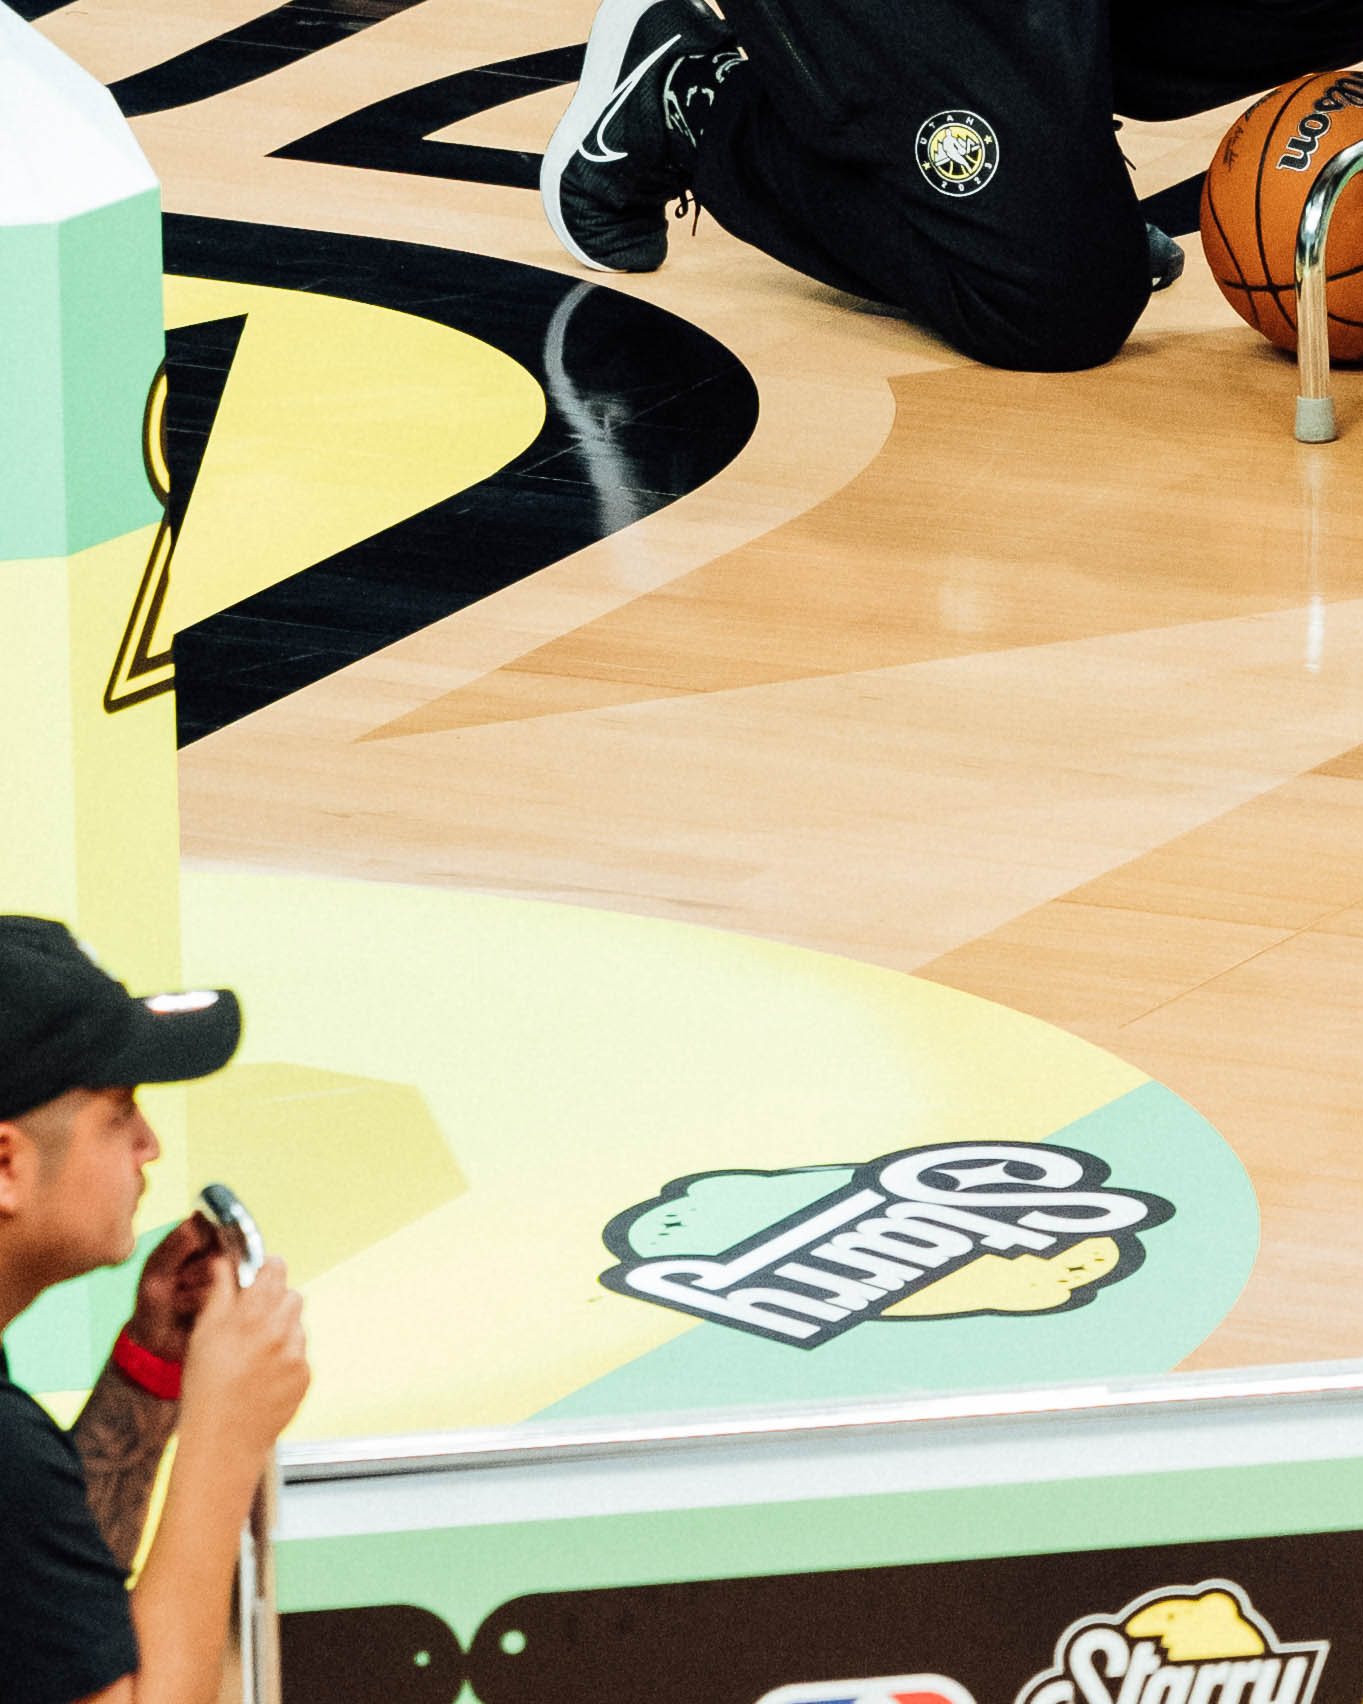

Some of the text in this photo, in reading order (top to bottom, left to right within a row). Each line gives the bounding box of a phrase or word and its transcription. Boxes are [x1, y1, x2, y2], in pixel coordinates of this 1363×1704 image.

[919, 113, 976, 146] UTAH
[940, 161, 994, 193] 2023
[625, 1144, 1149, 1341] Starry
